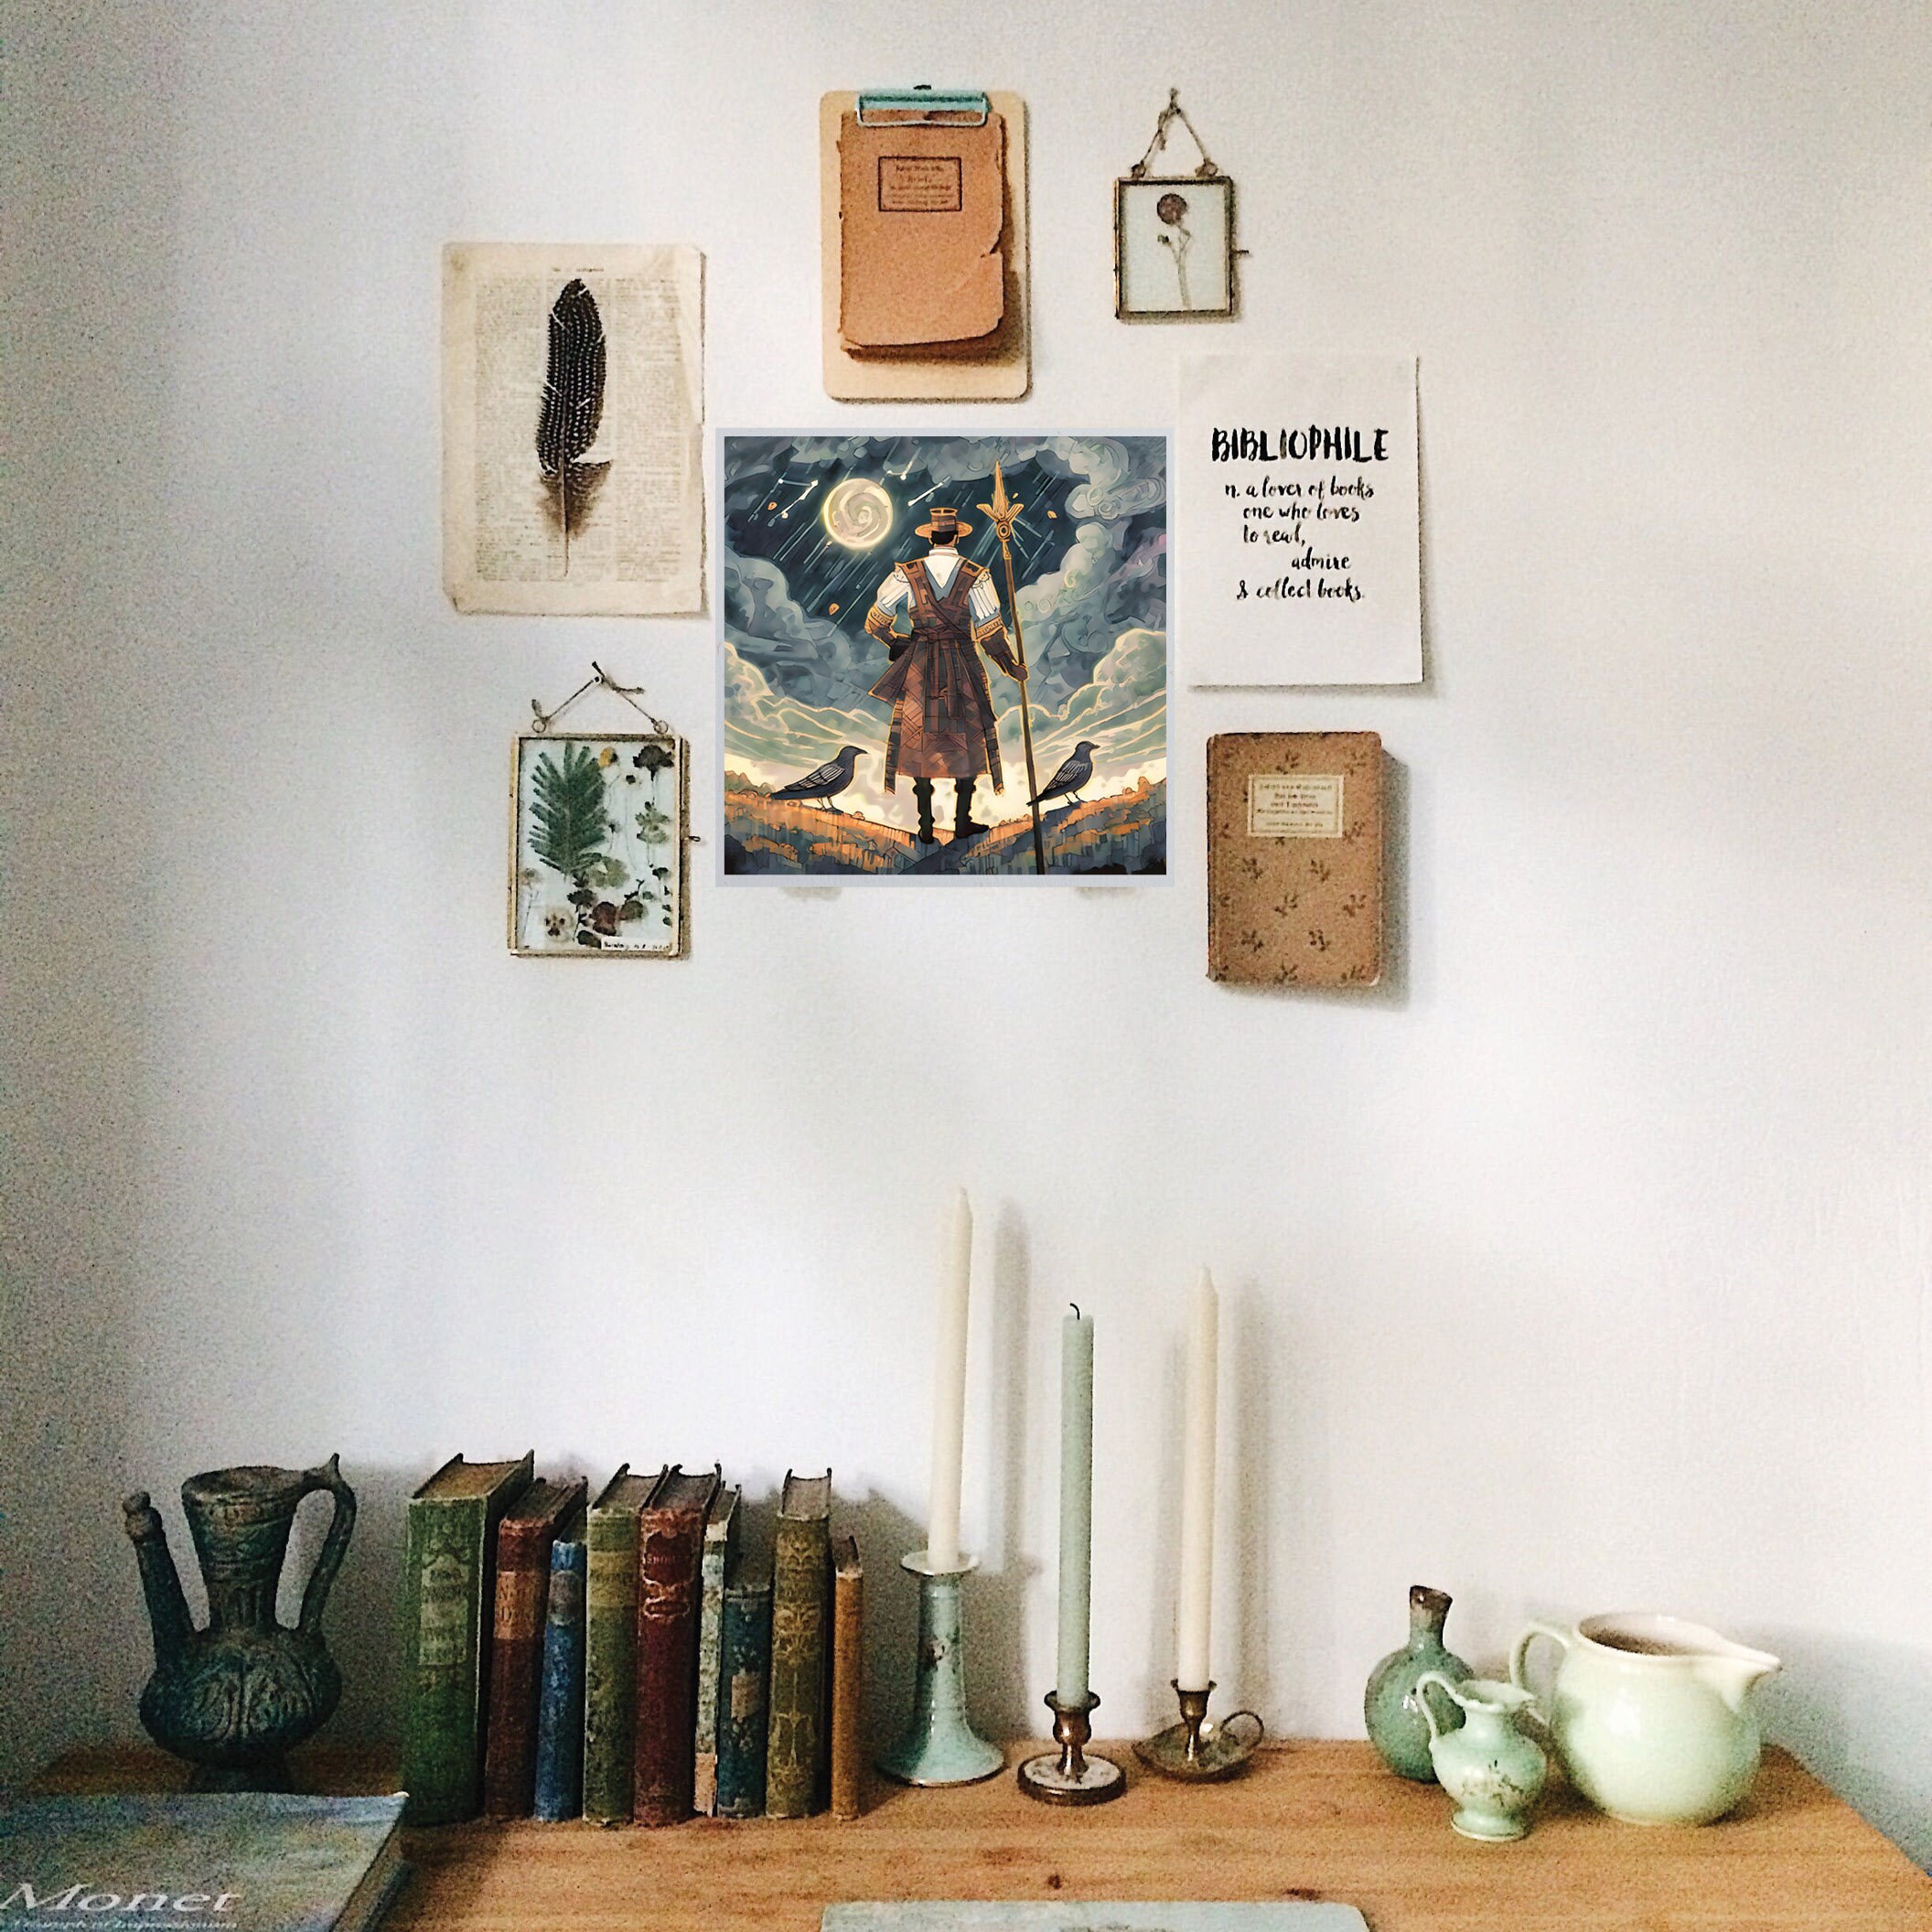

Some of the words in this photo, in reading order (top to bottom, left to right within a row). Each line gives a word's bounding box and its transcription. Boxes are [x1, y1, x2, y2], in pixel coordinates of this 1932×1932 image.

[1212, 424, 1389, 463] BIBLIOPHILE
[1225, 484, 1240, 499] n.
[1246, 485, 1259, 499] a
[1262, 476, 1302, 498] lover
[1308, 478, 1326, 501] of
[1330, 475, 1375, 501] books
[1243, 506, 1274, 520] one
[1279, 502, 1311, 521] who
[1316, 502, 1360, 522] loves
[1243, 524, 1259, 543] to
[1264, 522, 1305, 547] read,
[1291, 546, 1353, 570] admire
[1236, 579, 1250, 601] &
[1256, 576, 1312, 599] collect
[1317, 578, 1366, 603] books.
[0, 1883, 242, 1912] Monet
